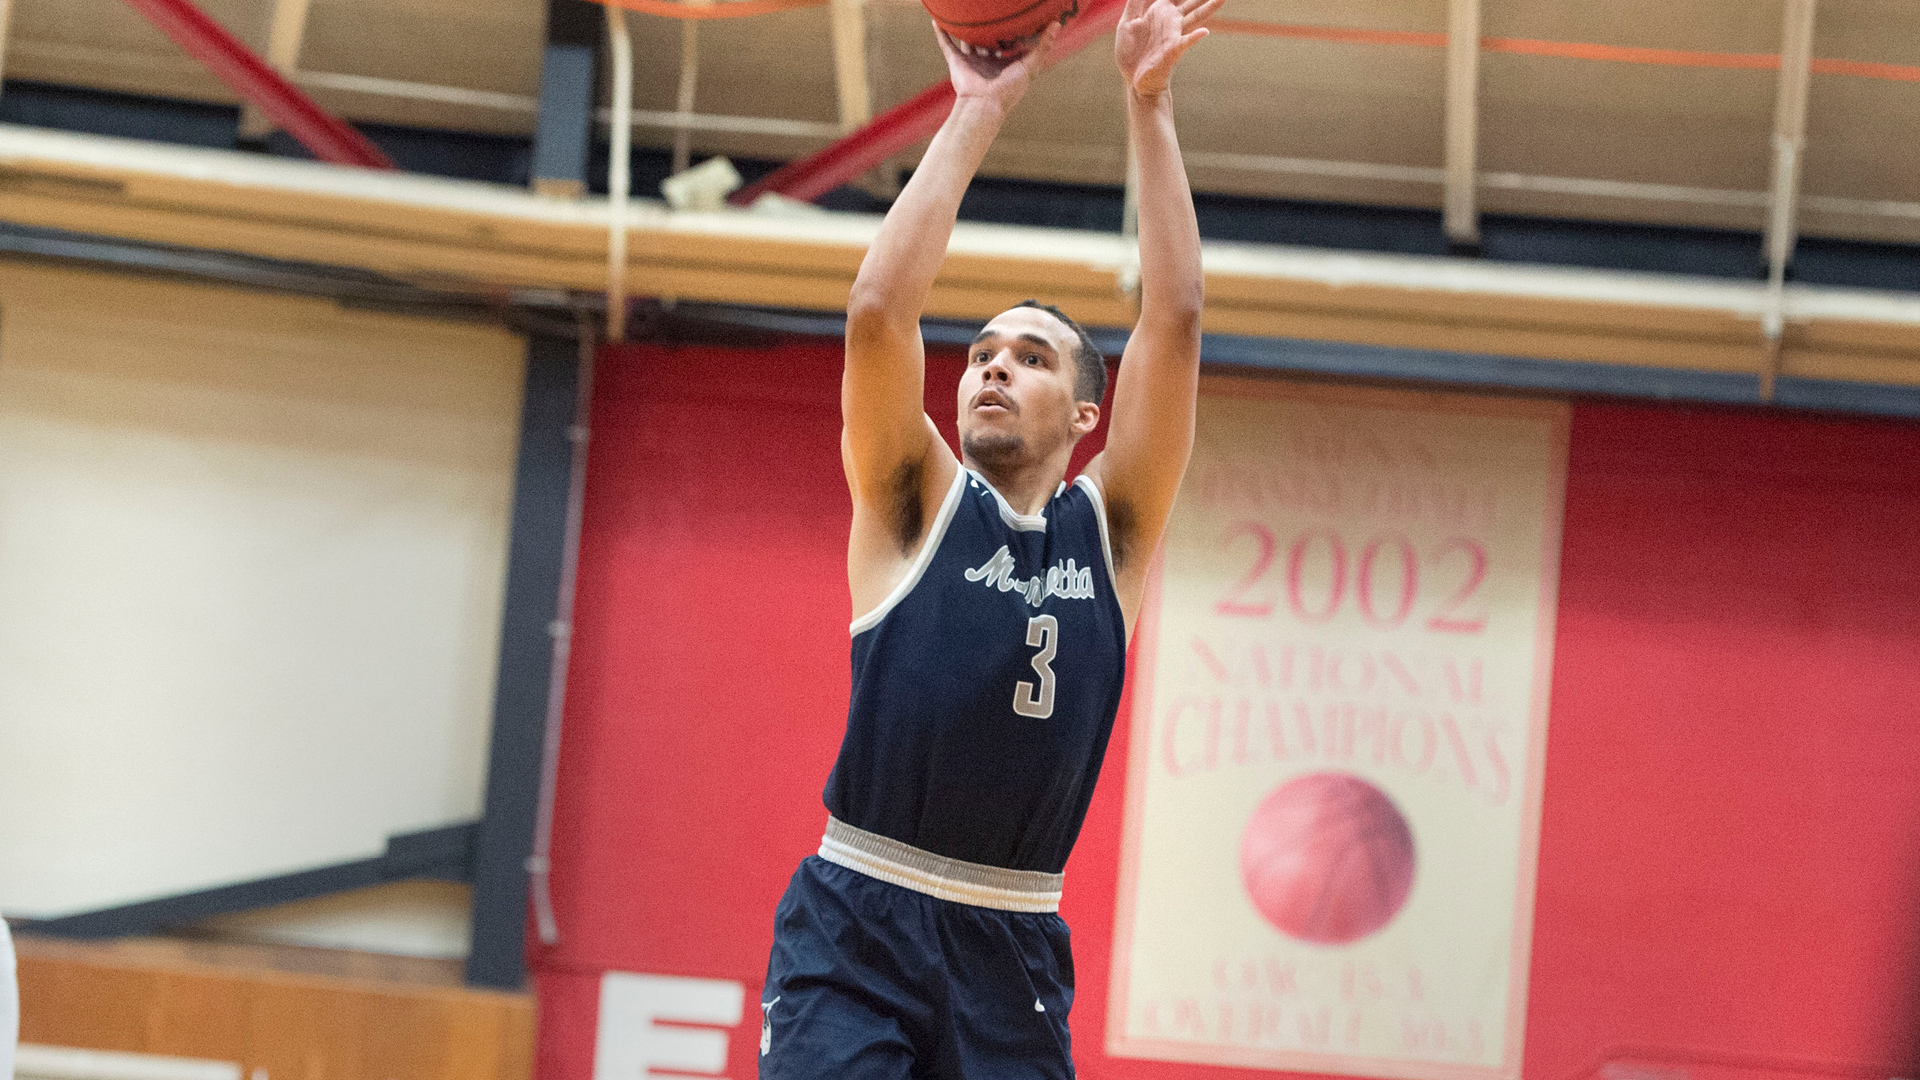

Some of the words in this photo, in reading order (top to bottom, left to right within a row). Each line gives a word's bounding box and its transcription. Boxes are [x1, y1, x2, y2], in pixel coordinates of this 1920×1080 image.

[1214, 520, 1487, 636] 2002
[1013, 614, 1058, 719] 3
[1192, 636, 1488, 706] NATIONAL
[1159, 692, 1513, 807] CHAMPIONS
